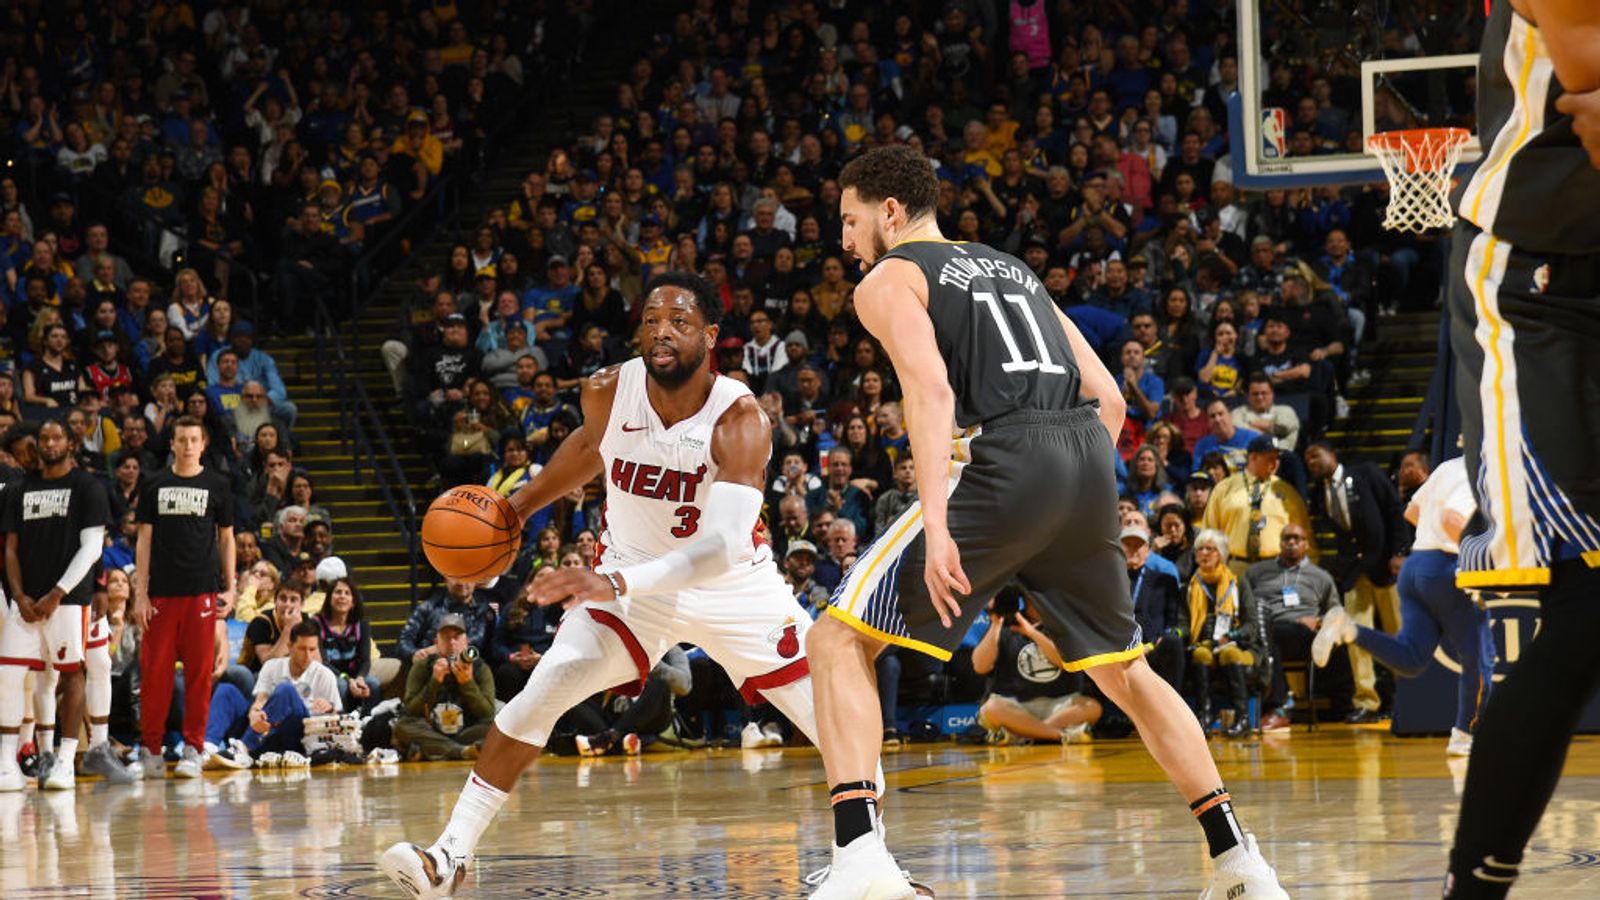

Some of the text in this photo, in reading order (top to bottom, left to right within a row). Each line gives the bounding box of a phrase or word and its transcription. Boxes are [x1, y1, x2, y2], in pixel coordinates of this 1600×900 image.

[972, 292, 1067, 374] 11
[611, 457, 708, 503] HEAT
[670, 505, 701, 538] 3
[948, 716, 976, 727] CHA
